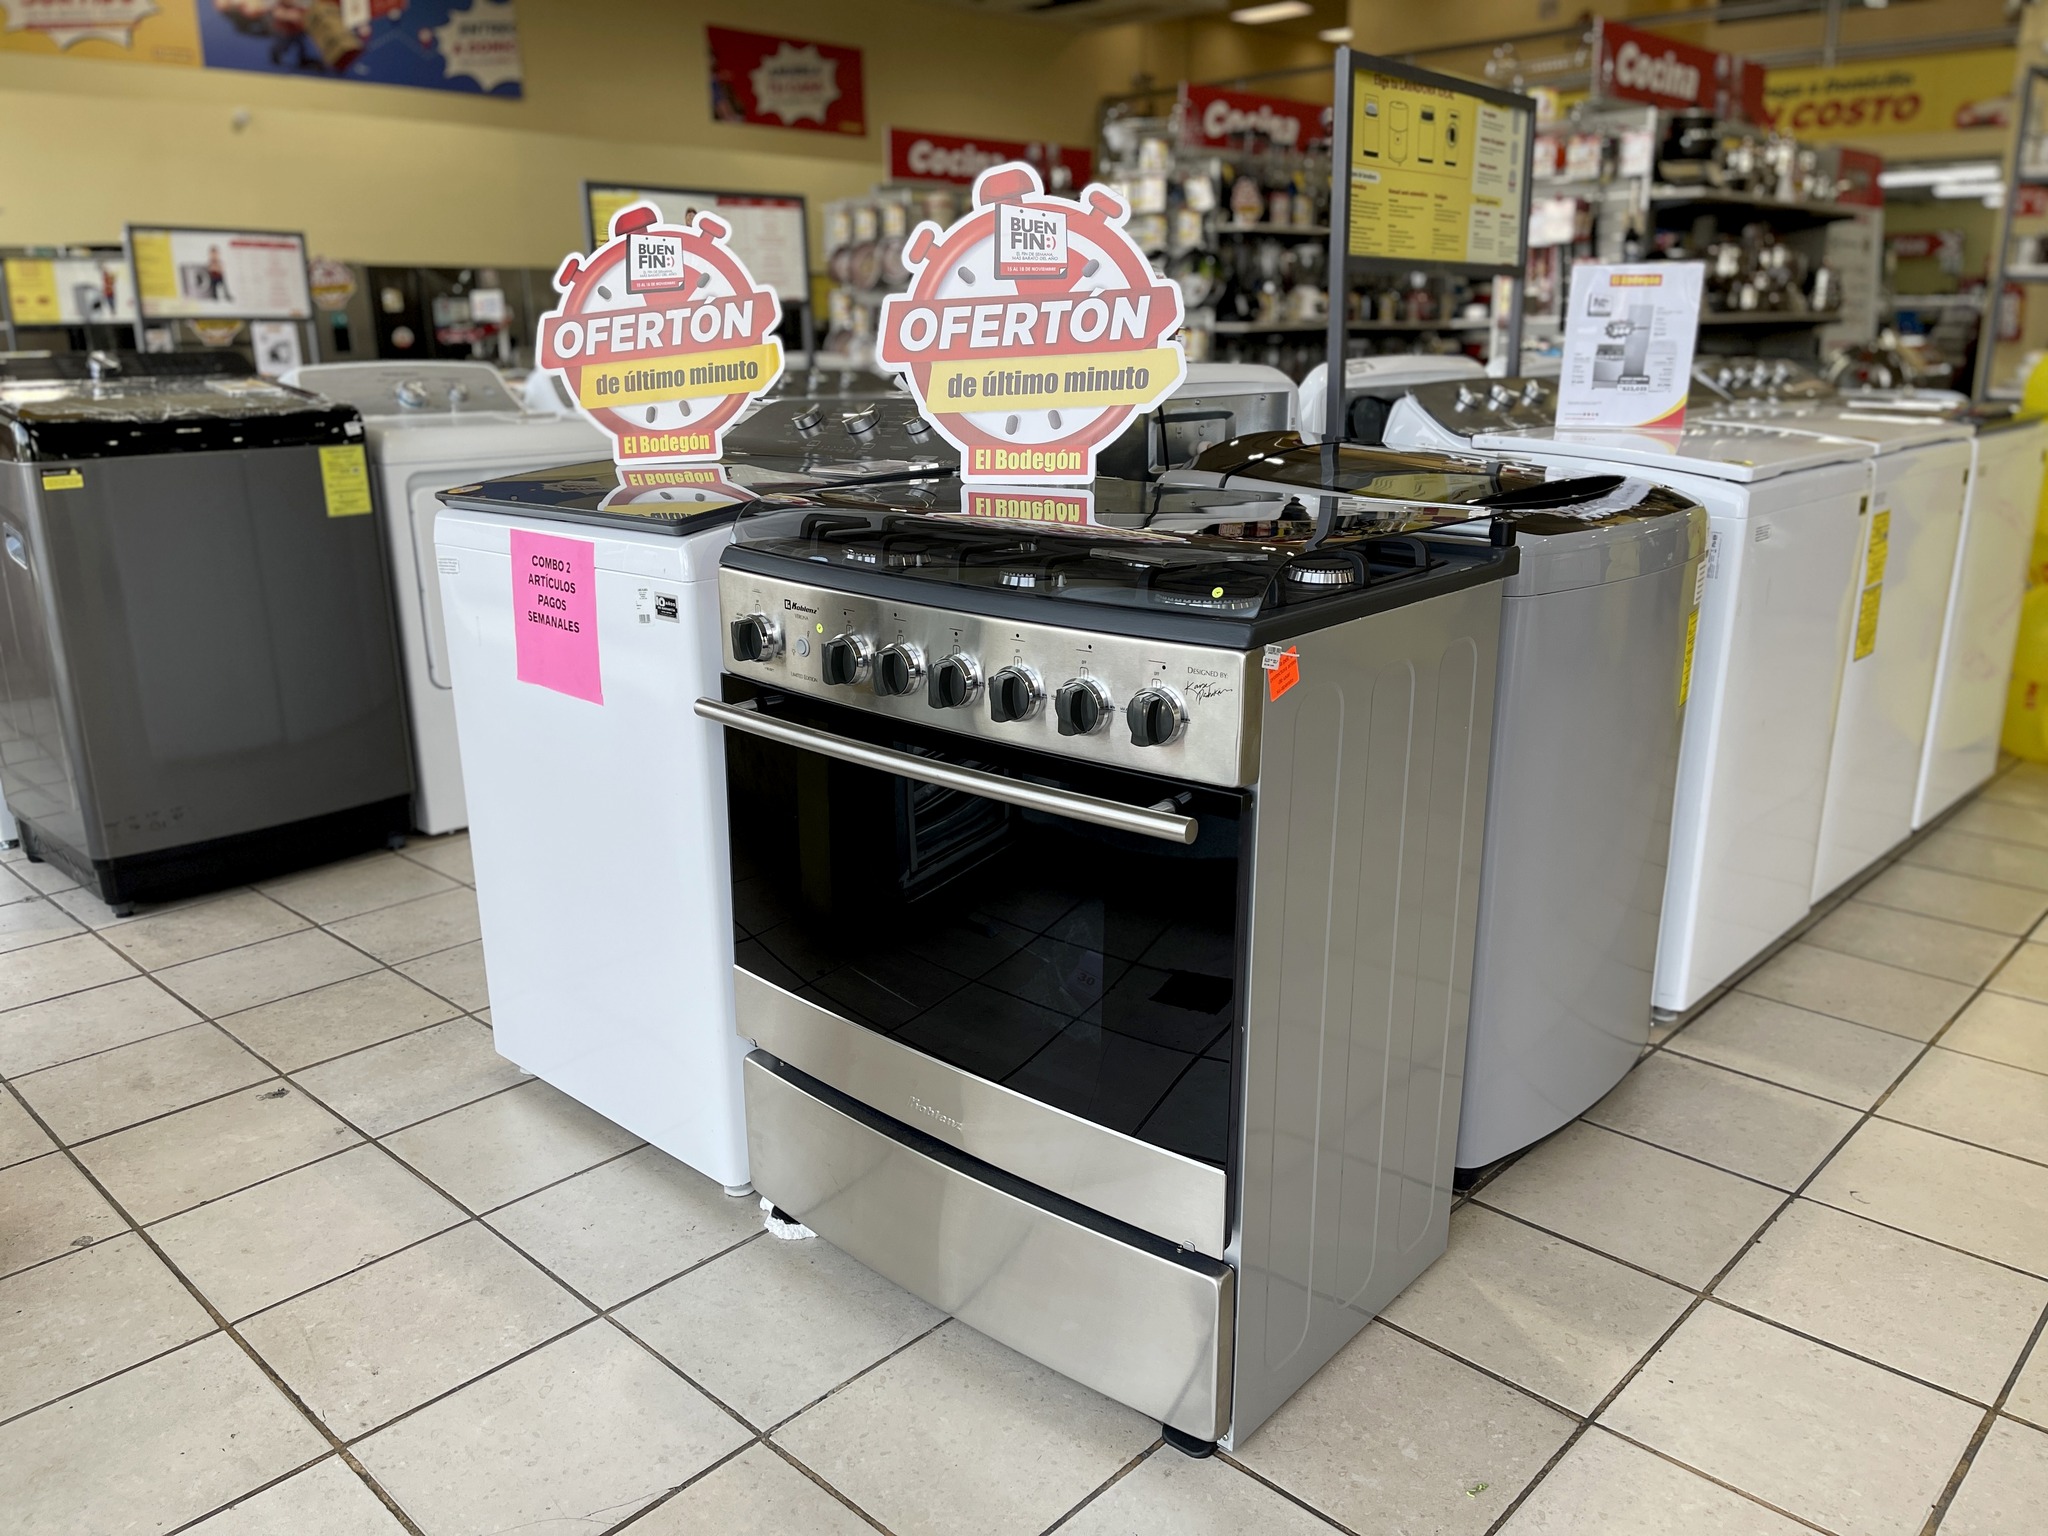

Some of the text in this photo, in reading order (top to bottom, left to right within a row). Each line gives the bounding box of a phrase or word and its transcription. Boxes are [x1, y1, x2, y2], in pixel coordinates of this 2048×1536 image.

[1615, 41, 1698, 99] Cocina
[1791, 93, 1922, 129] COSTO
[1011, 217, 1056, 235] BUEN
[638, 243, 675, 256] BUEN
[553, 295, 754, 359] OFERTÓN
[899, 286, 1151, 352] OFERTÓN
[596, 360, 759, 395] de último minuto
[947, 366, 1150, 399] de último minuto
[623, 432, 710, 454] El Bodegón
[975, 448, 1081, 473] El Bodegón
[531, 554, 571, 574] COMBO 2
[528, 572, 576, 594] ARTÍCULOS
[537, 593, 567, 611] PAGOS
[655, 596, 665, 607] 10
[791, 601, 818, 615] Koblenz
[527, 610, 580, 633] SEMANALES
[1187, 666, 1219, 678] DESIGNED
[907, 1094, 963, 1131] Koblenz
